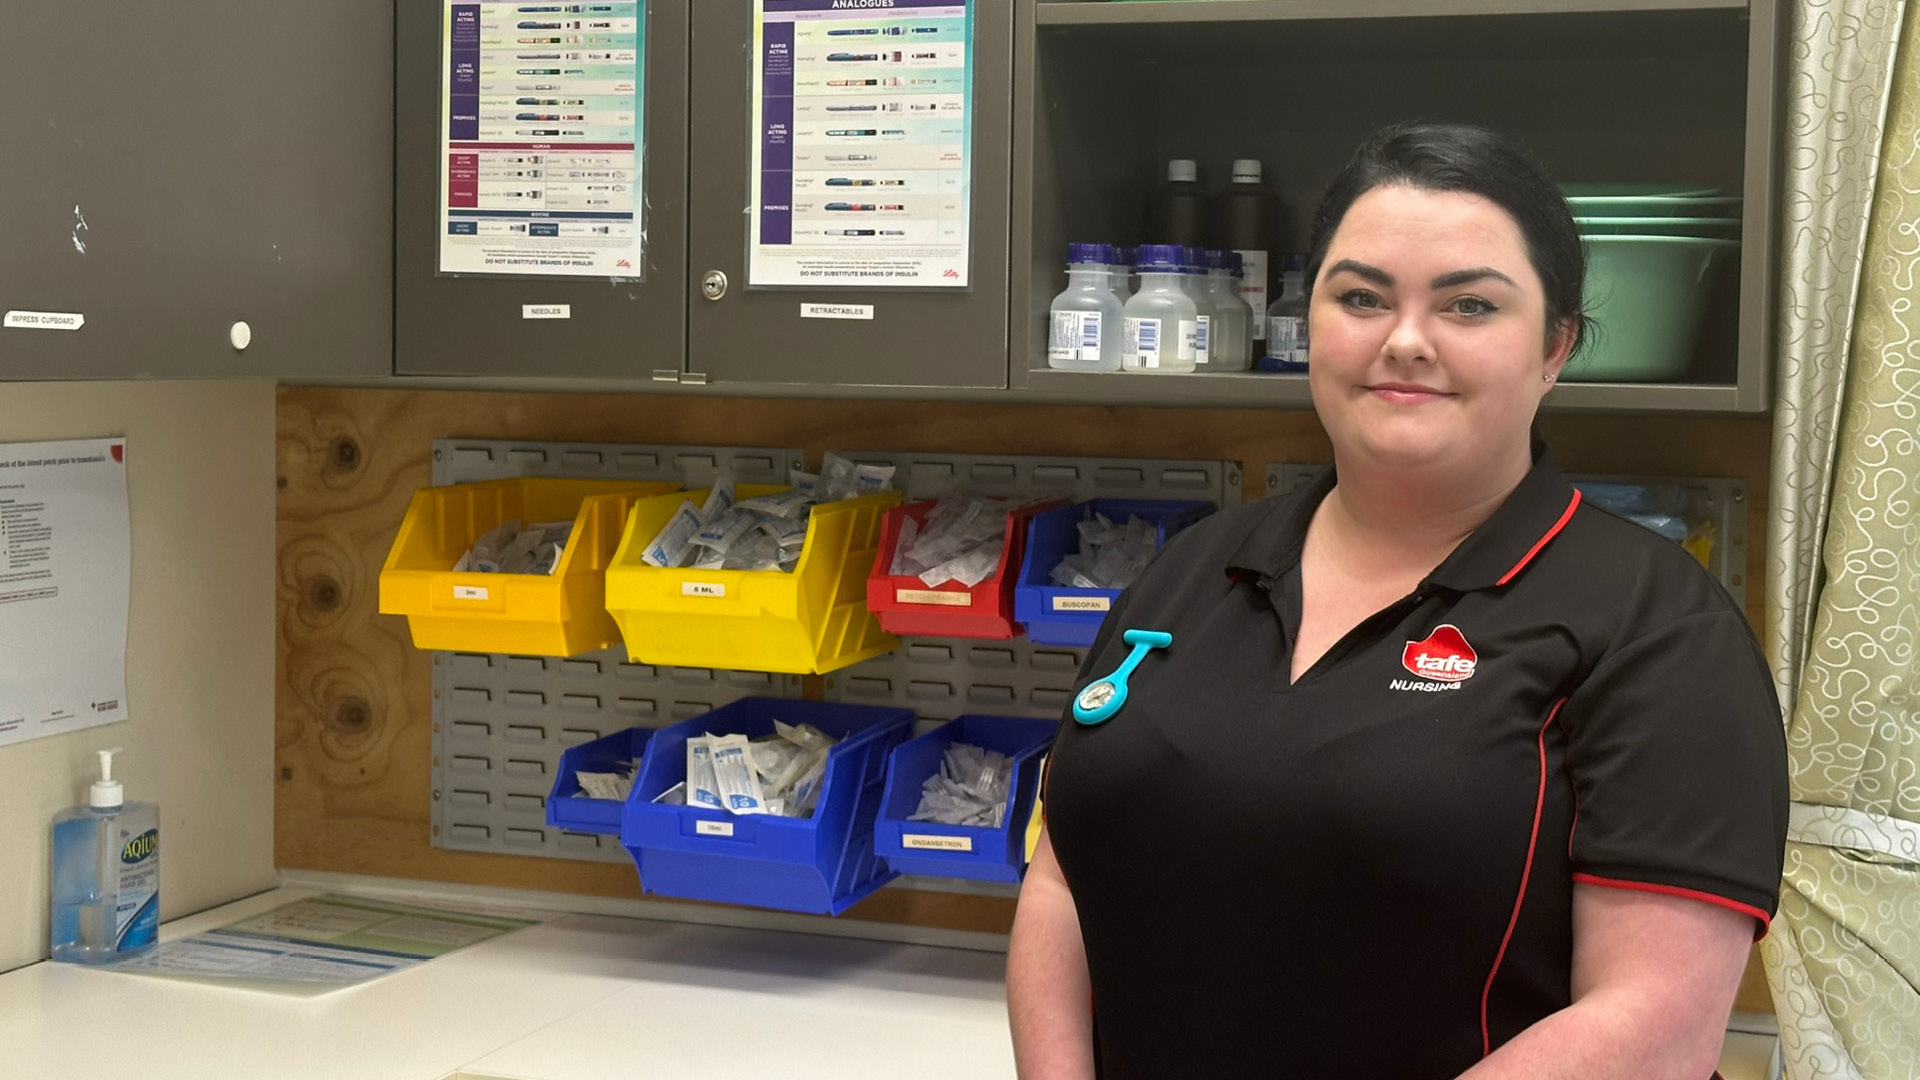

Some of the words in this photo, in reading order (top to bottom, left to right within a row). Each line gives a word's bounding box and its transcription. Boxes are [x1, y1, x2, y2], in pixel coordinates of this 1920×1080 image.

[831, 0, 894, 9] ANALOGUES
[530, 308, 562, 316] NEEDLES
[809, 307, 864, 316] RETRACTABLES
[41, 316, 75, 325] CUPBOARD
[1061, 601, 1101, 609] BUSCOPAN
[1414, 653, 1475, 673] tafe
[1389, 679, 1462, 692] NURSING
[911, 839, 963, 848] ONDANSETRON
